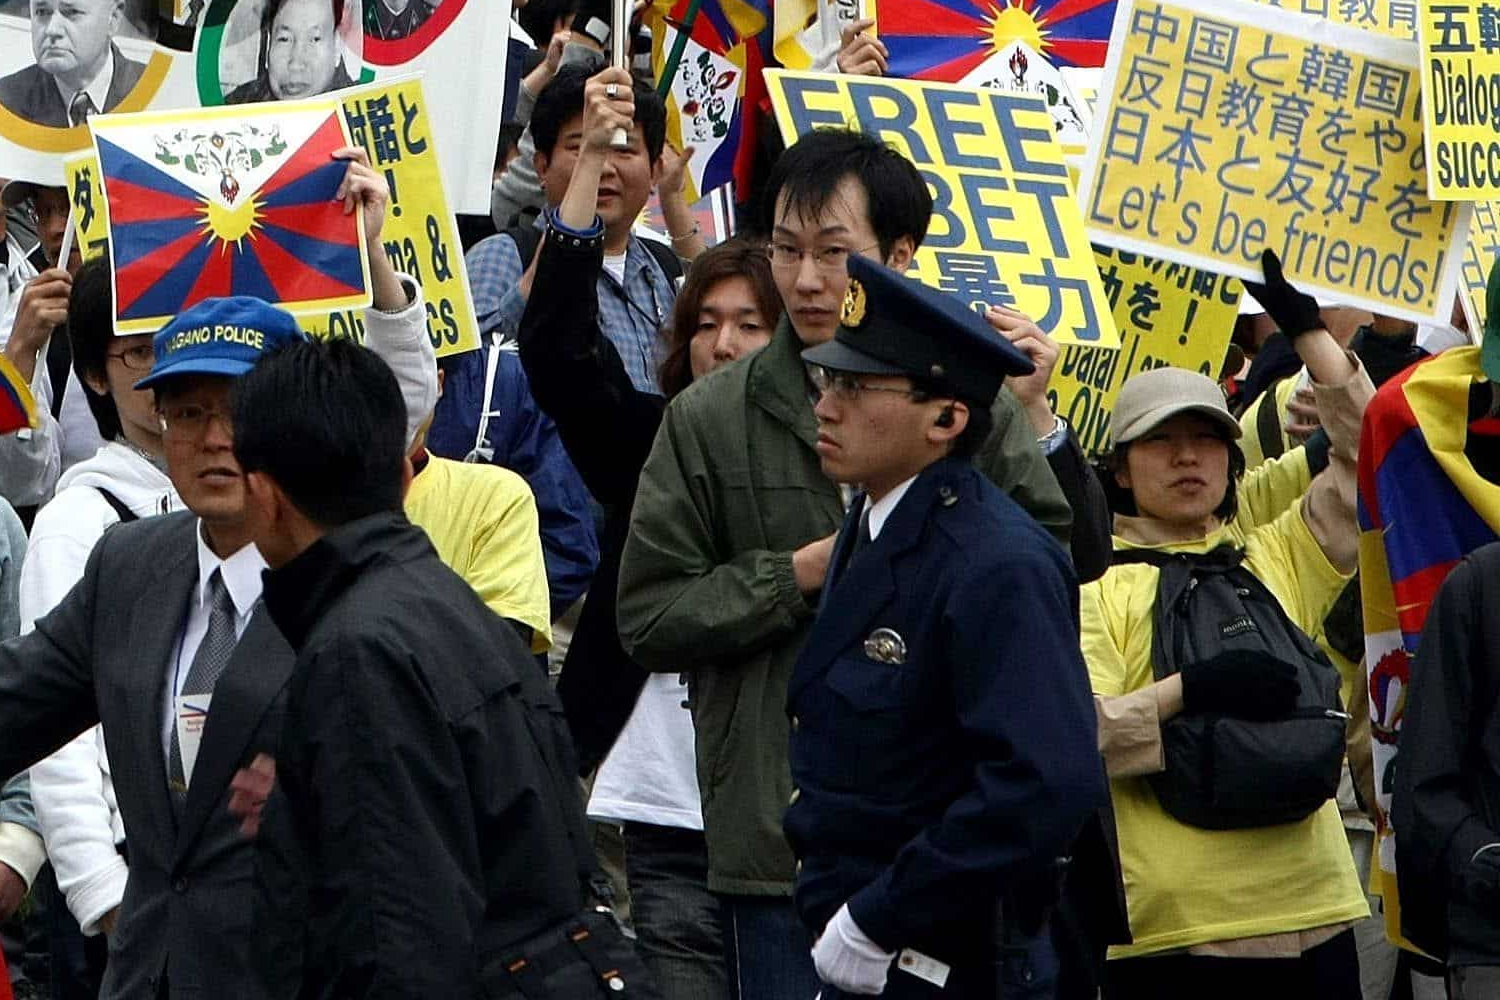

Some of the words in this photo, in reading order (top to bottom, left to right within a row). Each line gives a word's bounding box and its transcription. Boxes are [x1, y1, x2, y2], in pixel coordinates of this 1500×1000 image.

[1130, 4, 1422, 123] 中国と韓国
[779, 75, 1068, 179] FREE
[1090, 162, 1201, 246] Let's
[1212, 192, 1266, 261] be
[1281, 211, 1445, 308] friends!
[164, 326, 211, 354] NAGANO
[214, 325, 265, 350] POLICE
